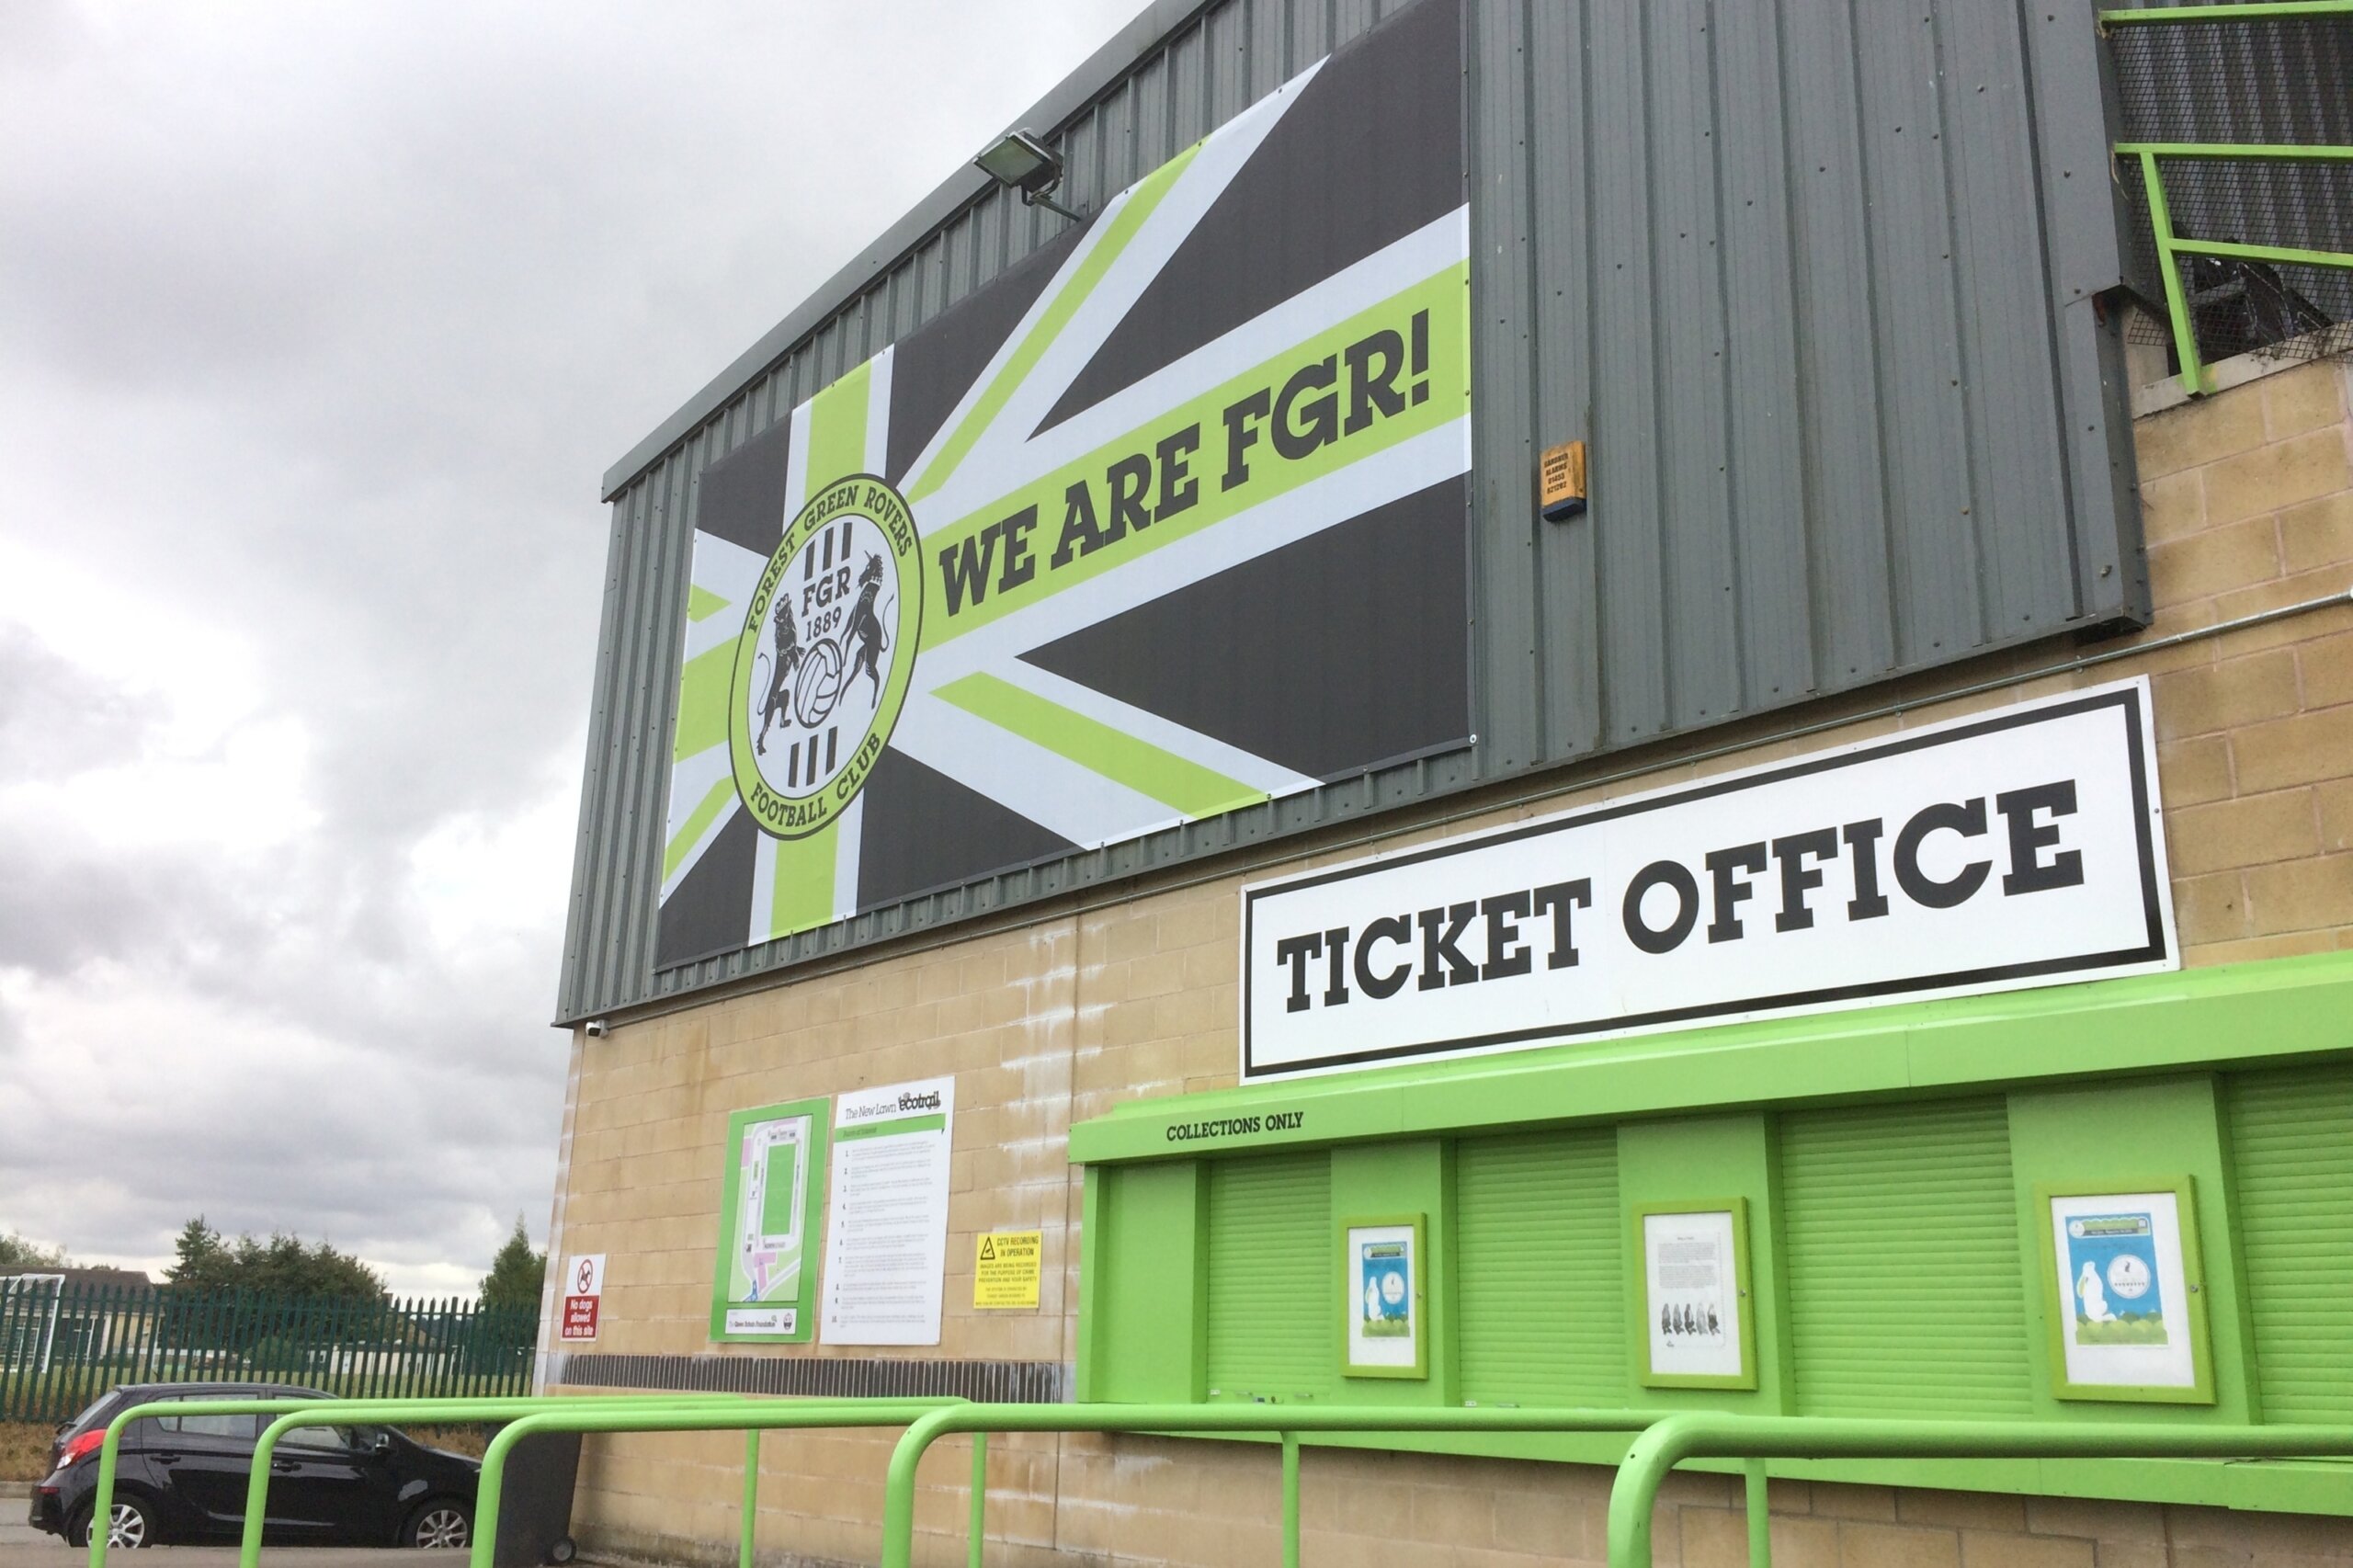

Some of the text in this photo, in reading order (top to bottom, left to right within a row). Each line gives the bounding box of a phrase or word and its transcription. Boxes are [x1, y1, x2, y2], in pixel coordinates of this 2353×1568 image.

[939, 308, 1429, 618] WE ARE FGR!
[748, 485, 912, 632] FOREST GREEN ROVERS
[801, 566, 851, 617] FGR
[806, 607, 842, 642] 1889
[751, 733, 881, 827] FOOTBALL CLUB
[1278, 778, 2084, 1014] TICKET OFFICE
[846, 1108, 858, 1119] The
[858, 1106, 875, 1118] New
[875, 1103, 896, 1116] Lawn
[1167, 1111, 1304, 1142] COLLECTIONS ONLY
[996, 1235, 1039, 1246] CCTV RECORDING
[1006, 1247, 1034, 1256] OPERATION
[570, 1300, 593, 1312] No dogs
[570, 1312, 591, 1324] allowed
[564, 1325, 594, 1336] on this site
